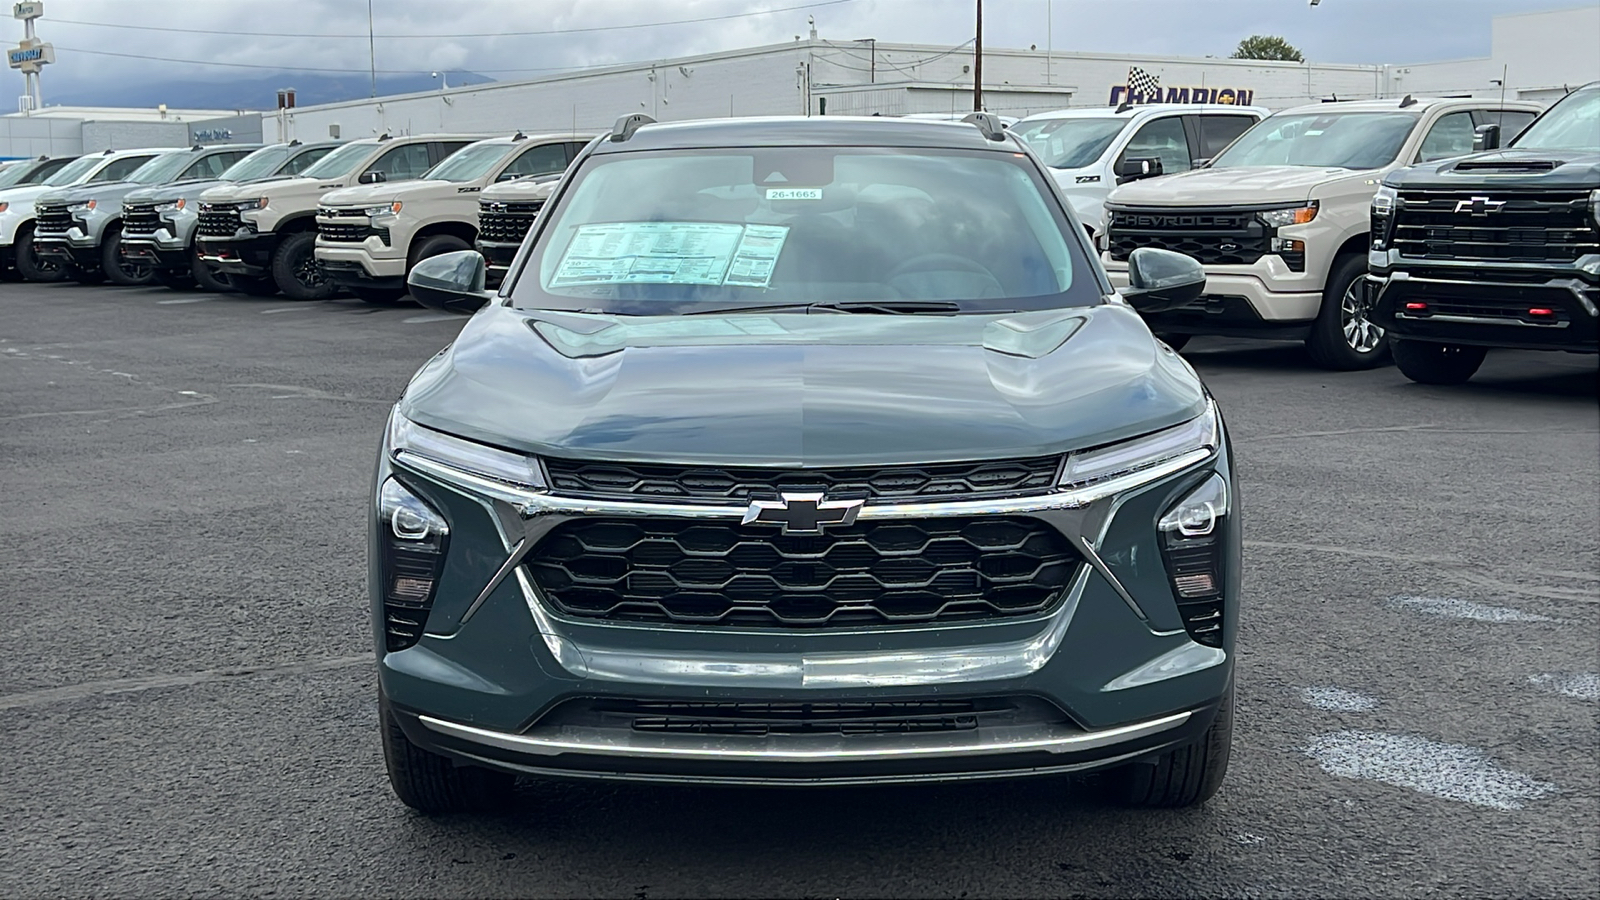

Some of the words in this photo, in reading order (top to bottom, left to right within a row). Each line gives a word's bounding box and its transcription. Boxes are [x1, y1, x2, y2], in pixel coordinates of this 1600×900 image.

[1109, 86, 1254, 107] CHAMPION
[771, 191, 817, 199] 26-1665
[1114, 214, 1247, 227] CHEVROLET
